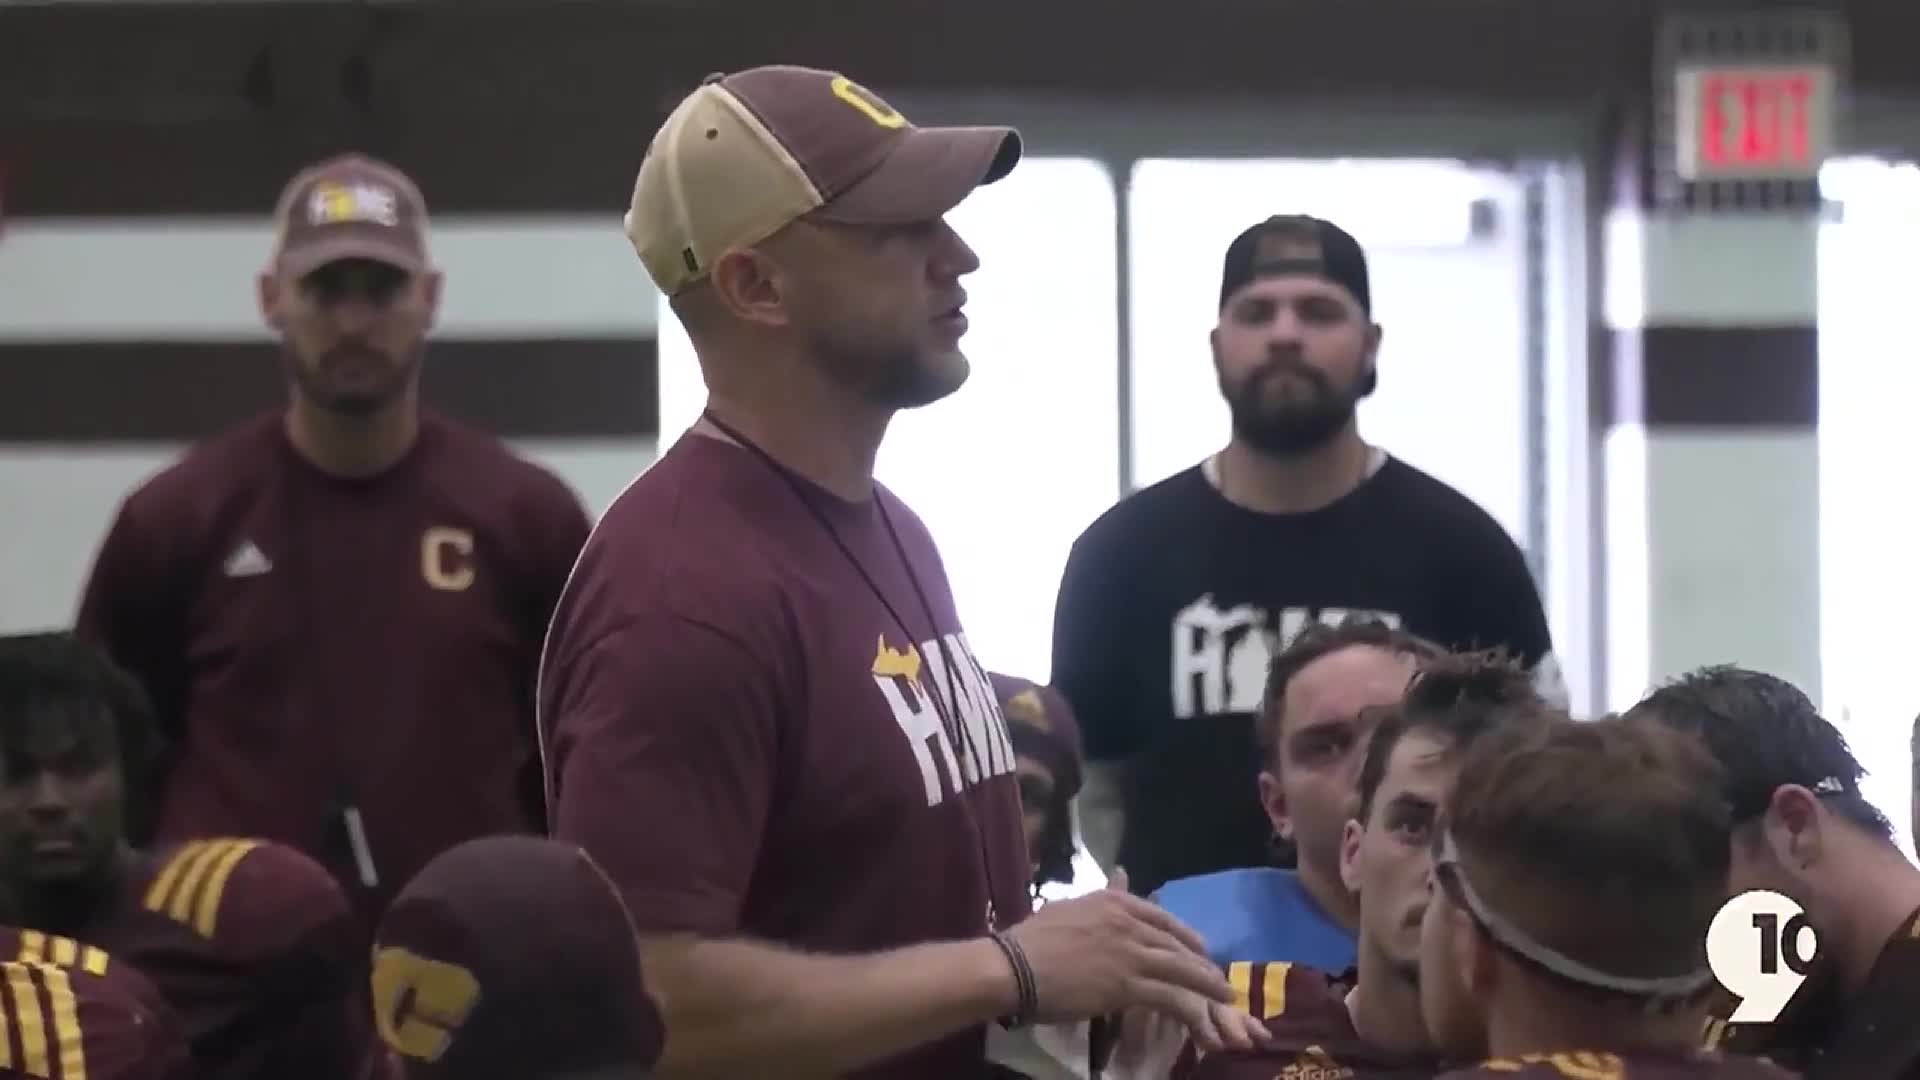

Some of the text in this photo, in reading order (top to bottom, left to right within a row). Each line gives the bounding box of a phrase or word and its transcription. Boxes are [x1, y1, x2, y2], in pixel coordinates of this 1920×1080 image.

[1704, 69, 1813, 165] EXIT
[421, 526, 475, 591] C
[369, 947, 480, 1061] C
